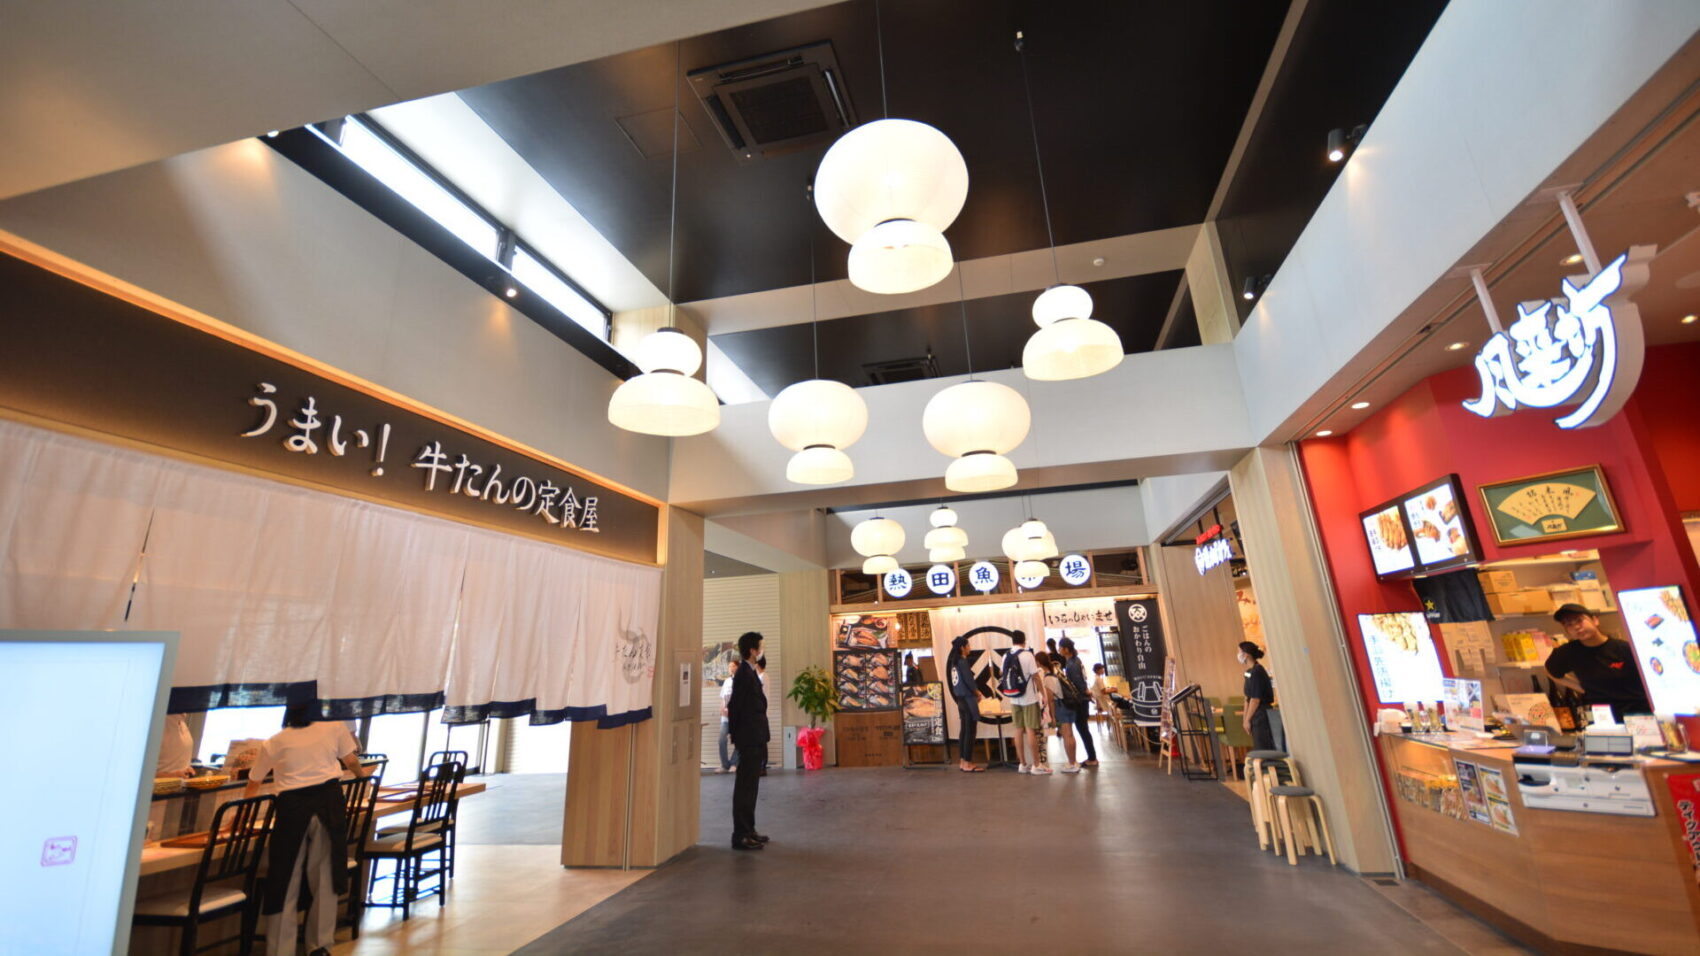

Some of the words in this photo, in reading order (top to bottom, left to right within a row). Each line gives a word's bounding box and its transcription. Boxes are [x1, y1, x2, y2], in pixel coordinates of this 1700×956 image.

[411, 440, 600, 533] 牛たんの定食屋
[887, 560, 1087, 590] 熱田魚場
[1132, 626, 1146, 670] おかわり自由
[1142, 625, 1152, 653] ごはんの
